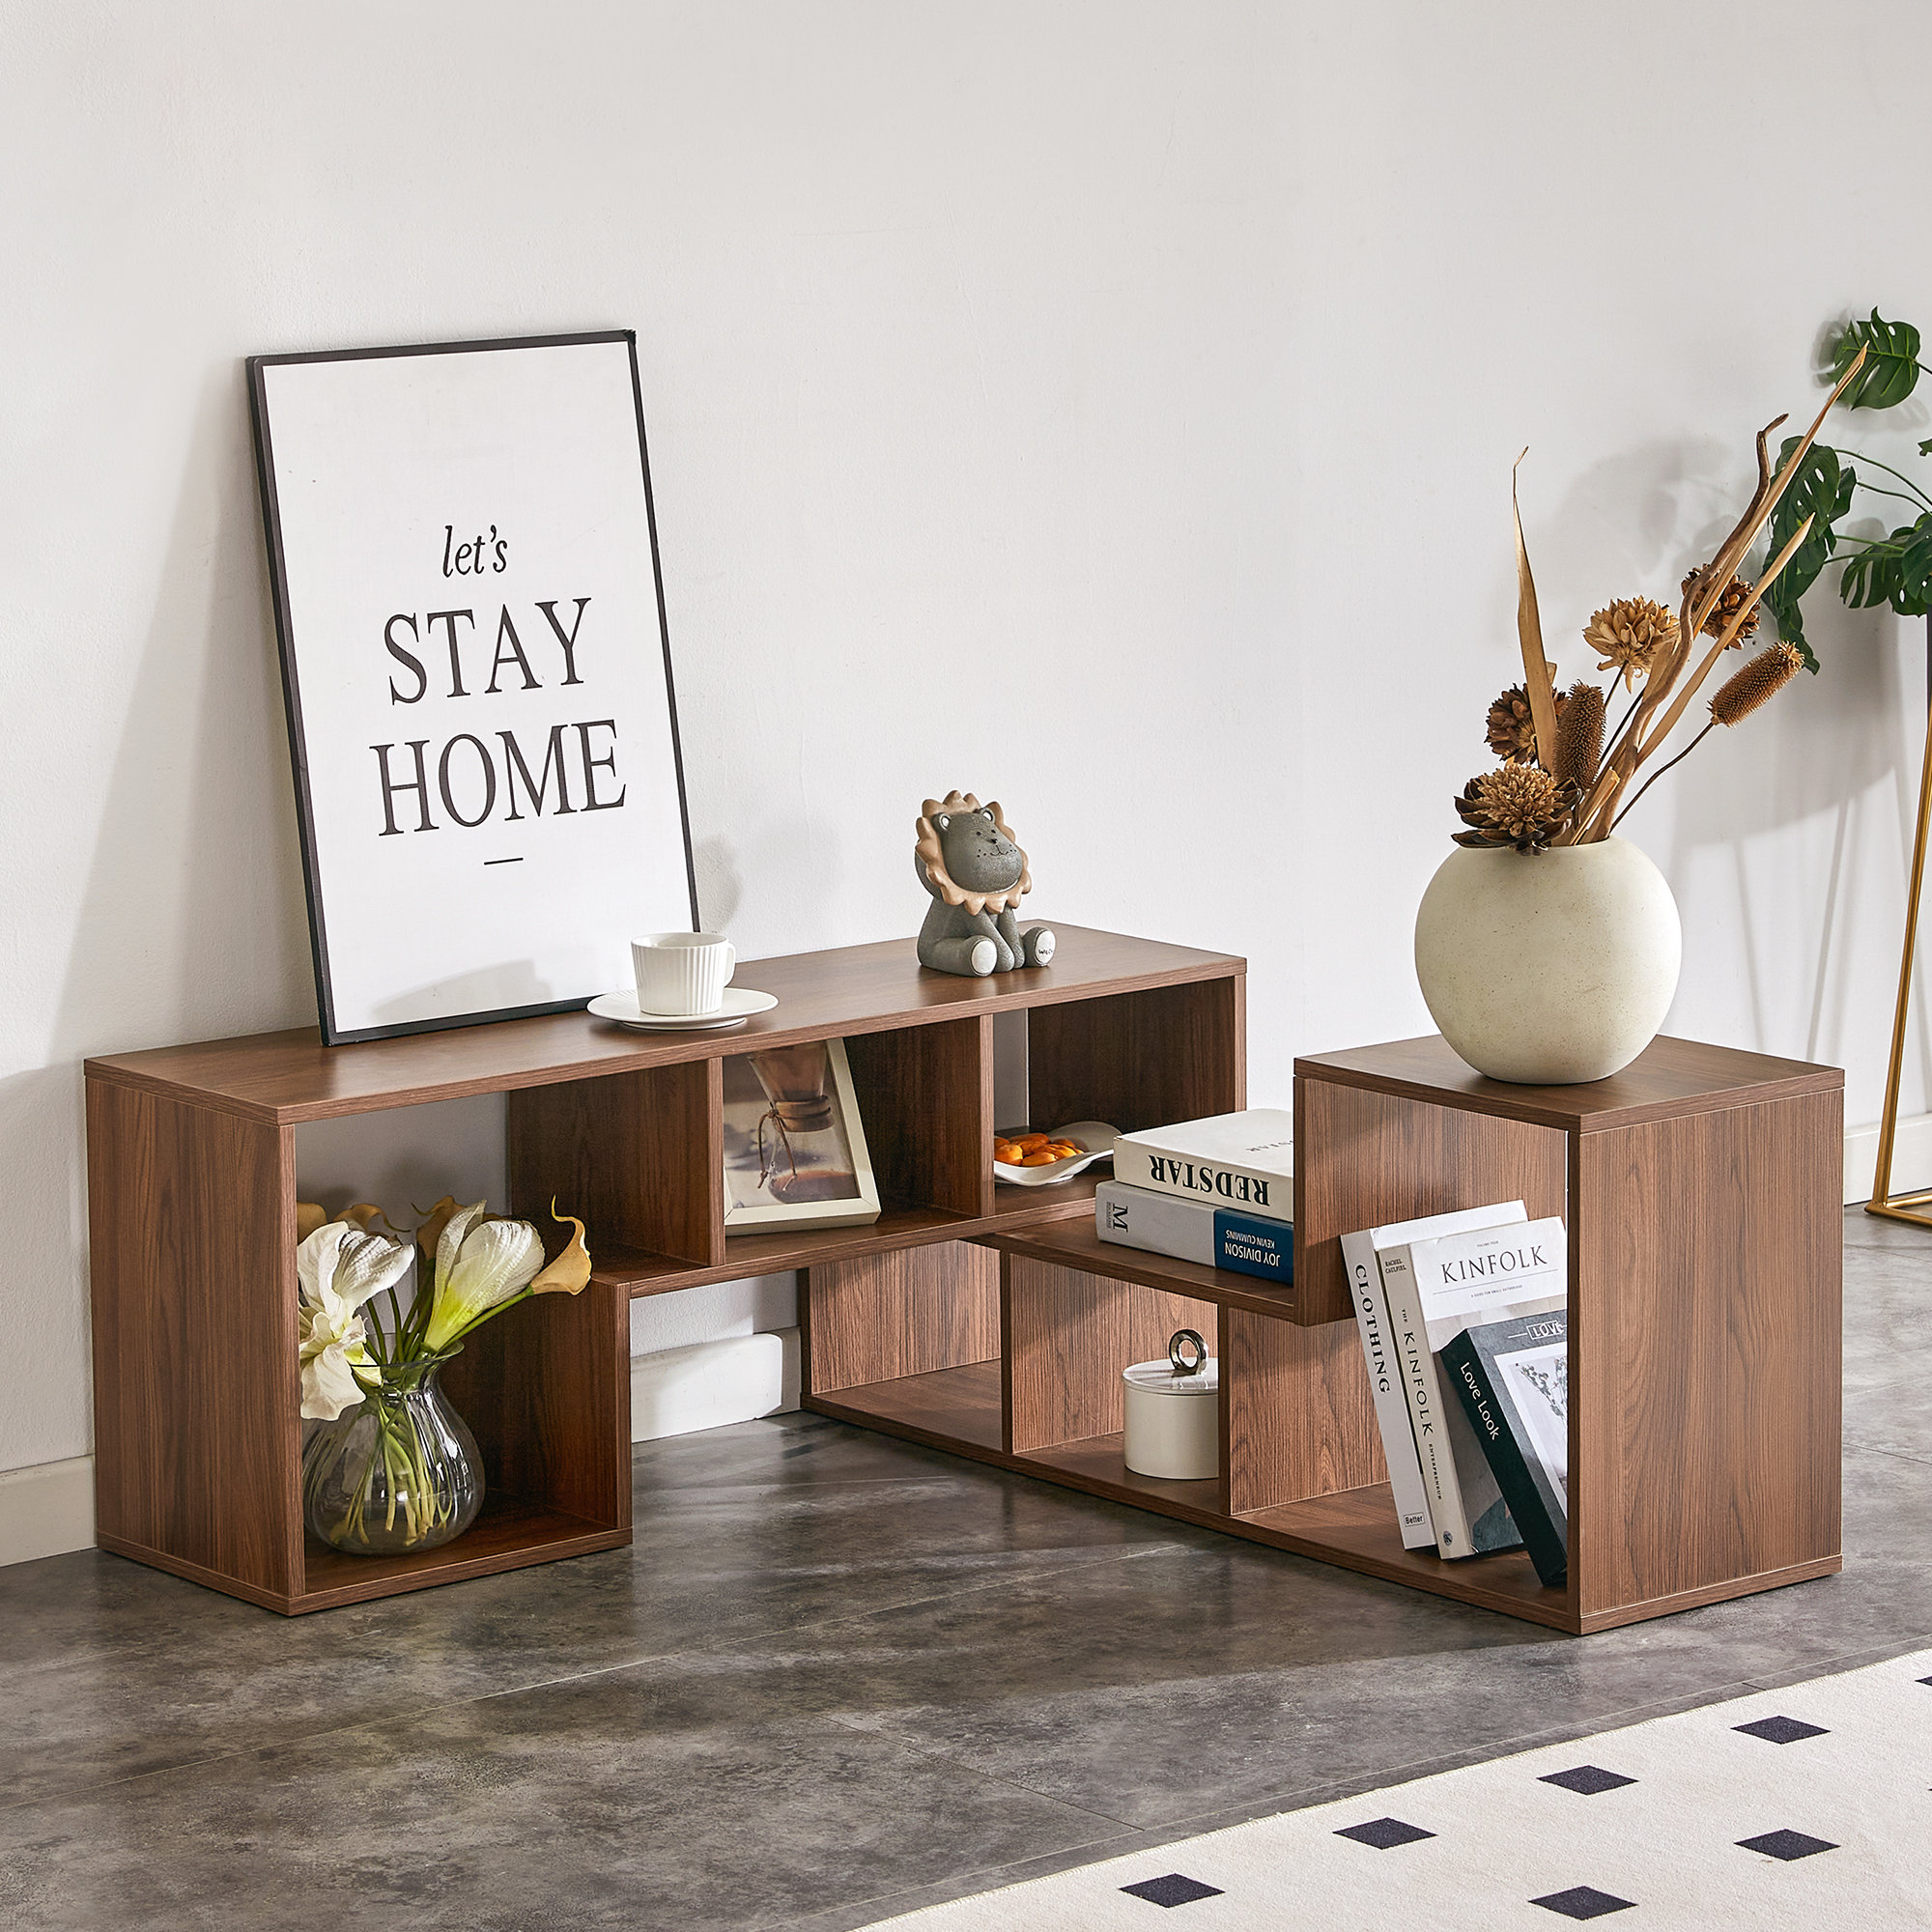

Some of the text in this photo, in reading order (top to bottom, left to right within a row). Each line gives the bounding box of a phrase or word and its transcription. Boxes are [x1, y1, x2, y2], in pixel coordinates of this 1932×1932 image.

[442, 525, 508, 579] let's
[384, 597, 592, 706] STAY
[369, 719, 627, 837] HOME
[1148, 1154, 1270, 1207] REDSTAR
[1112, 1203, 1128, 1234] M
[1225, 1229, 1275, 1250] KEVIN CUMMINS
[1224, 1241, 1281, 1267] JOY DIVISON
[1440, 1244, 1548, 1284] KINFOLK
[1355, 1264, 1391, 1394] CLOTHING
[1404, 1330, 1435, 1437] KINFOLK
[1460, 1361, 1500, 1441] Love Look
[1405, 1515, 1424, 1525] Better
